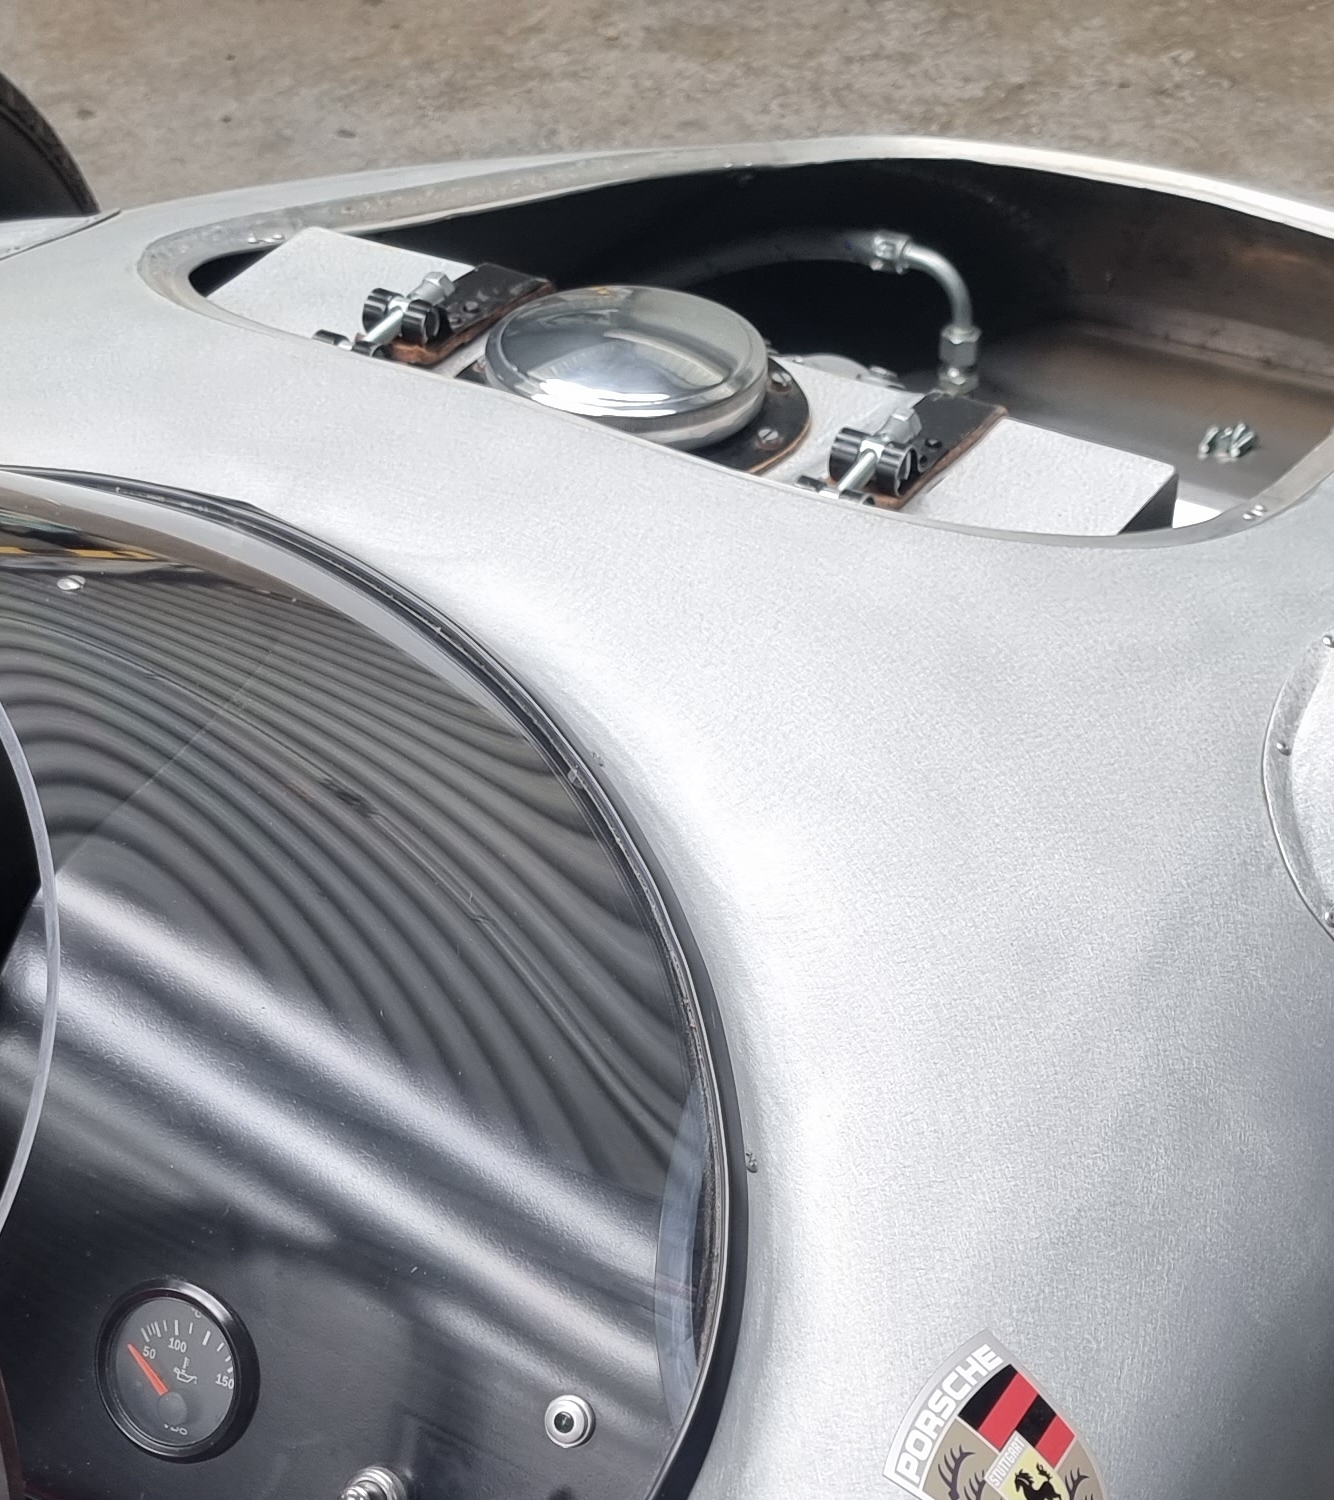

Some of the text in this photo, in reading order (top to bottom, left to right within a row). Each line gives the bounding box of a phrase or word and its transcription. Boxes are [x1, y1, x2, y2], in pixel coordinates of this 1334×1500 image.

[142, 1345, 156, 1360] 50
[168, 1336, 187, 1353] 100
[215, 1373, 235, 1390] 150
[896, 1343, 1004, 1485] PORSCHE
[988, 1435, 1025, 1488] STUTTGART
